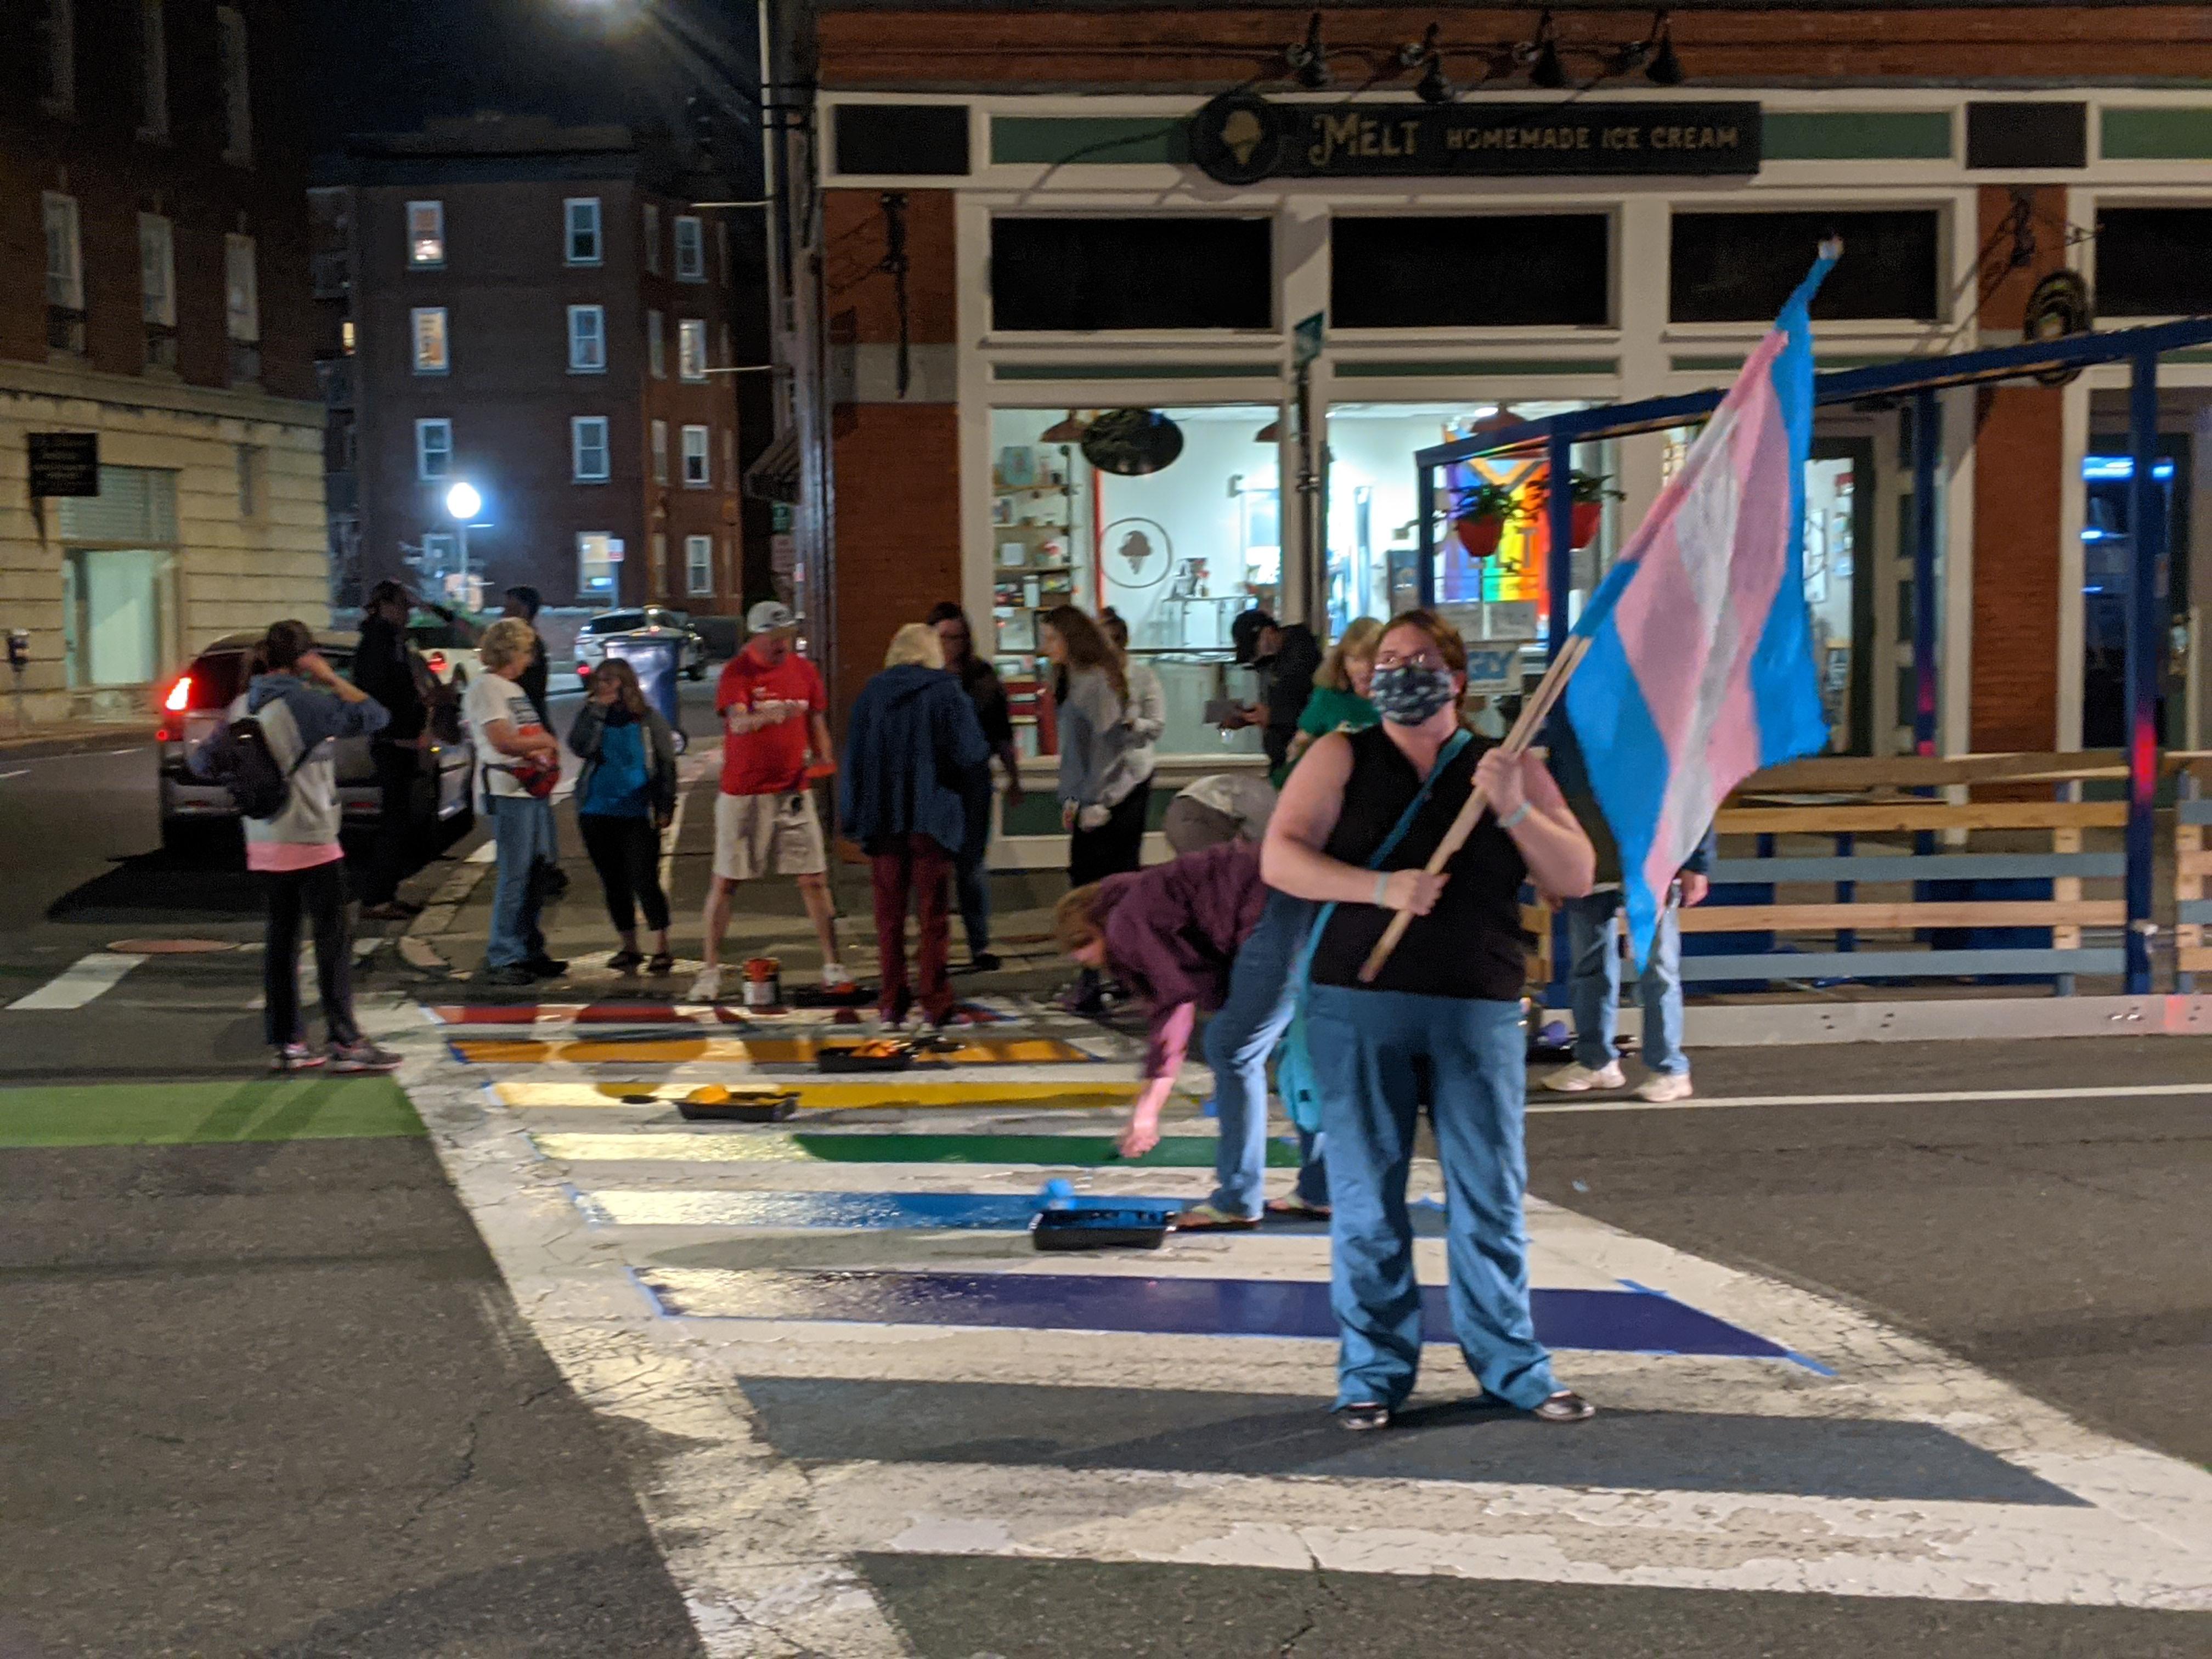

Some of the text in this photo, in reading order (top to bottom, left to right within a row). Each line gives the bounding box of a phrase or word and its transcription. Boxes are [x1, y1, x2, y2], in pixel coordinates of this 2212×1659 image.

[1308, 112, 1738, 167] MELT HOMEMADE ICE CREAM
